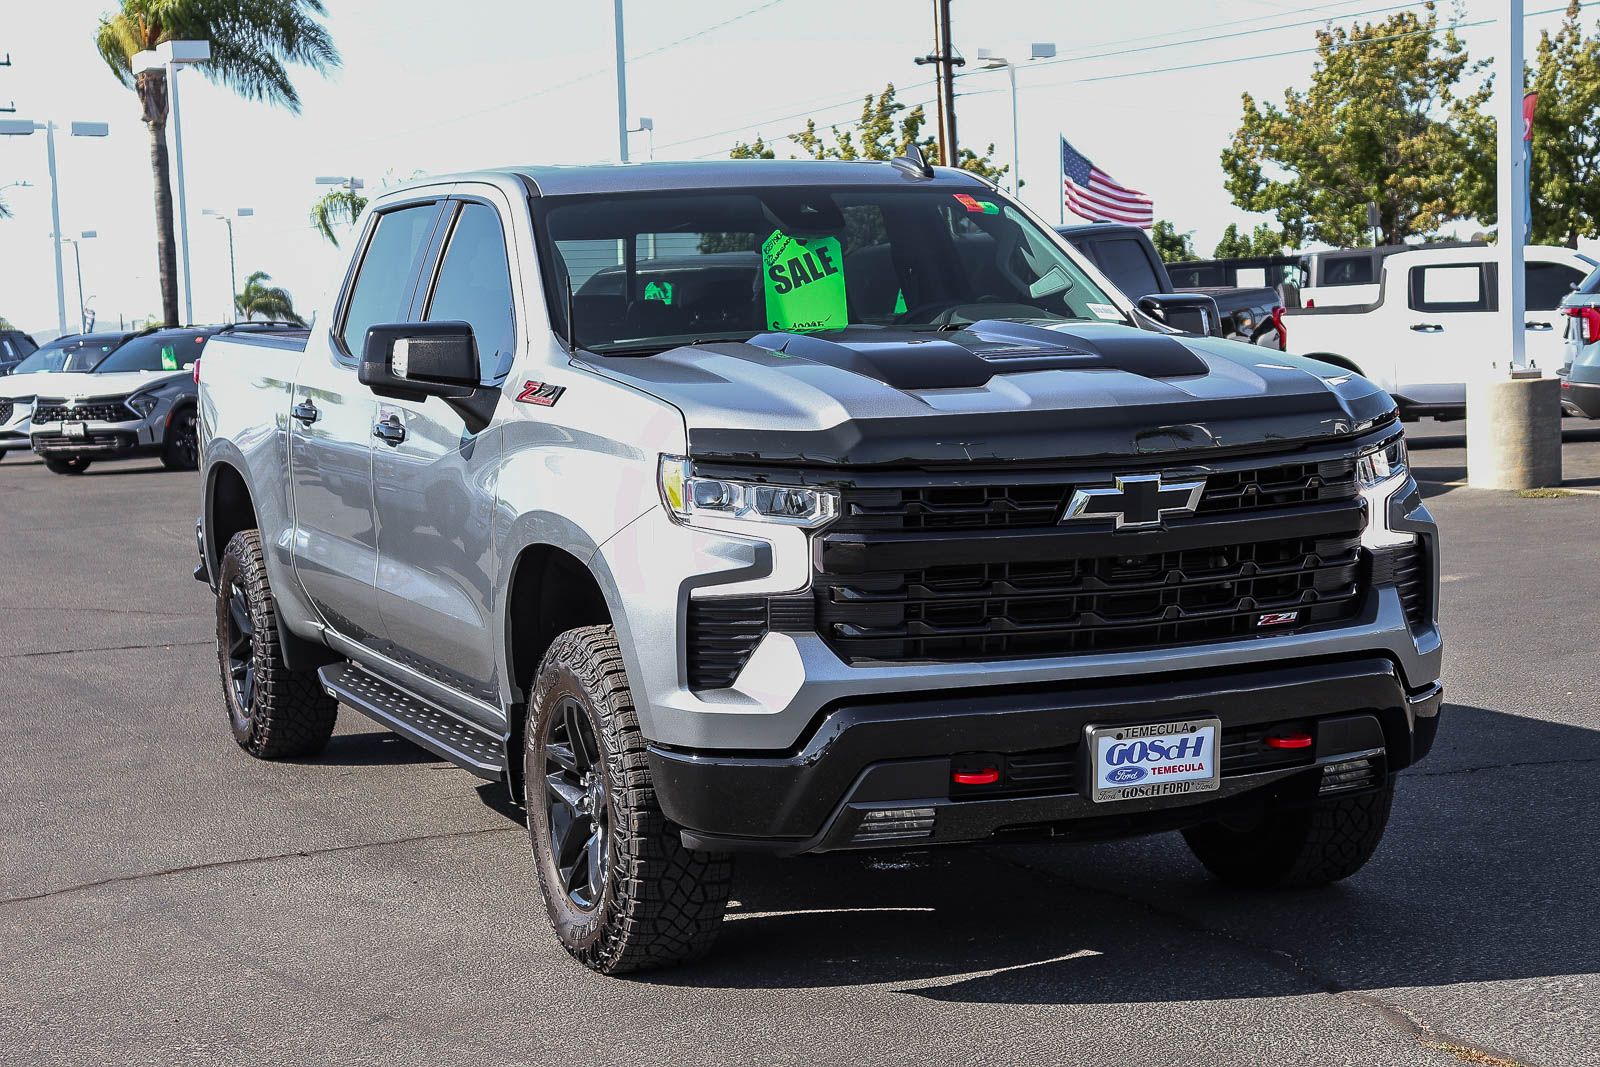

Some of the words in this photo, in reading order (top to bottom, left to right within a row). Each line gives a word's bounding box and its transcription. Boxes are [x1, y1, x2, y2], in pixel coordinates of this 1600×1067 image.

[768, 246, 839, 294] SALE
[515, 380, 567, 407] Z71
[1257, 611, 1298, 626] Z71
[1124, 722, 1189, 738] TEMECULA
[1114, 769, 1139, 781] Ford
[1150, 762, 1204, 776] TEMECULA
[1163, 781, 1190, 795] FORD
